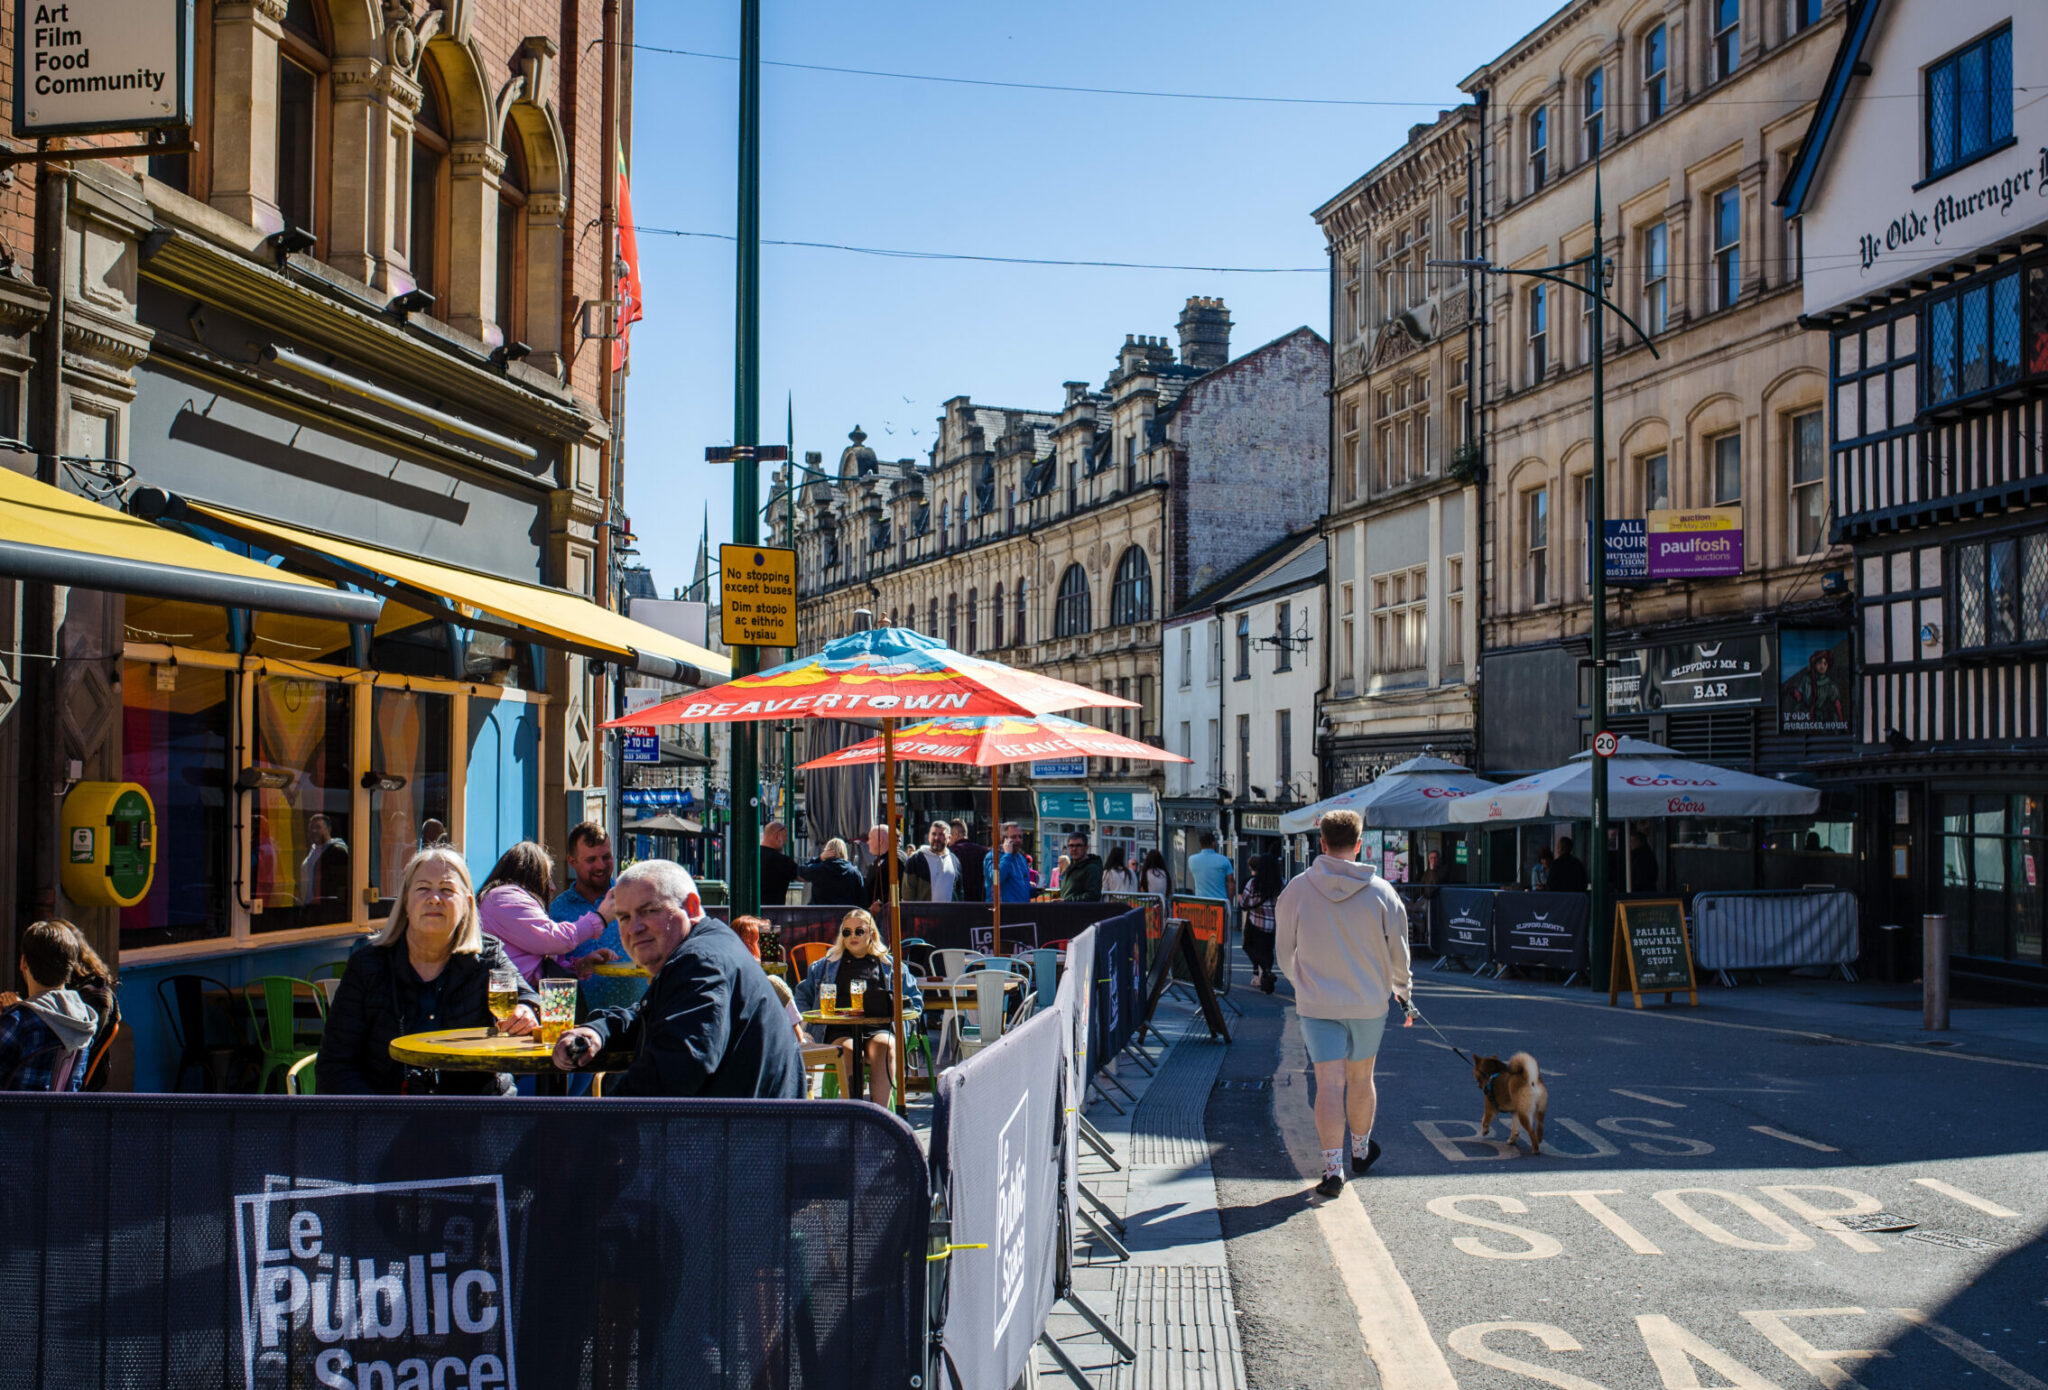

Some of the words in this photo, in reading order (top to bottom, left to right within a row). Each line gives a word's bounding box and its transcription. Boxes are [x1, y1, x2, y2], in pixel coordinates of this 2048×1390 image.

[34, 4, 69, 25] Art
[35, 27, 82, 48] Film
[35, 48, 89, 72] Food
[34, 68, 166, 96] Community
[1859, 233, 1882, 278] Ye
[1886, 208, 1928, 251] Olde
[1933, 167, 2035, 246] Murenger
[1680, 513, 1711, 523] auction
[1683, 522, 1698, 530] May
[1700, 521, 1718, 529] 2019
[1618, 521, 1643, 534] ALL
[1660, 536, 1731, 557] paulfosh
[1694, 552, 1731, 562] auctions
[727, 567, 742, 580] No
[746, 569, 790, 584] stopping
[1605, 568, 1629, 577] 01633
[725, 583, 760, 595] except
[763, 584, 793, 595] buses
[731, 601, 752, 613] Dim
[756, 603, 787, 616] stopio
[735, 616, 748, 626] ac
[751, 615, 784, 627] eithrio
[744, 628, 777, 641] bysiau
[1671, 661, 1711, 678] SLIPPING
[1693, 682, 1728, 700] BAR
[680, 692, 972, 719] BEAVERTOWN
[631, 737, 641, 748] TO
[642, 737, 655, 749] LET
[1597, 738, 1615, 750] 20
[1620, 775, 1719, 788] Coors
[1667, 797, 1706, 814] Coors
[1458, 931, 1473, 941] BAR
[1635, 928, 1658, 937] PALE
[1659, 927, 1677, 936] ALE
[1528, 937, 1549, 947] BAR
[1633, 938, 1664, 947] BROWN
[1665, 936, 1683, 946] ALE
[1641, 947, 1672, 957] PORTER
[1647, 956, 1674, 966] STOUT
[1413, 1116, 1716, 1162] BUS
[998, 1138, 1010, 1188] Le
[997, 1154, 1026, 1258] Public
[1426, 1185, 1886, 1260] STOP
[253, 1200, 324, 1264] Le
[1002, 1226, 1026, 1304] Space
[257, 1252, 499, 1348] Public
